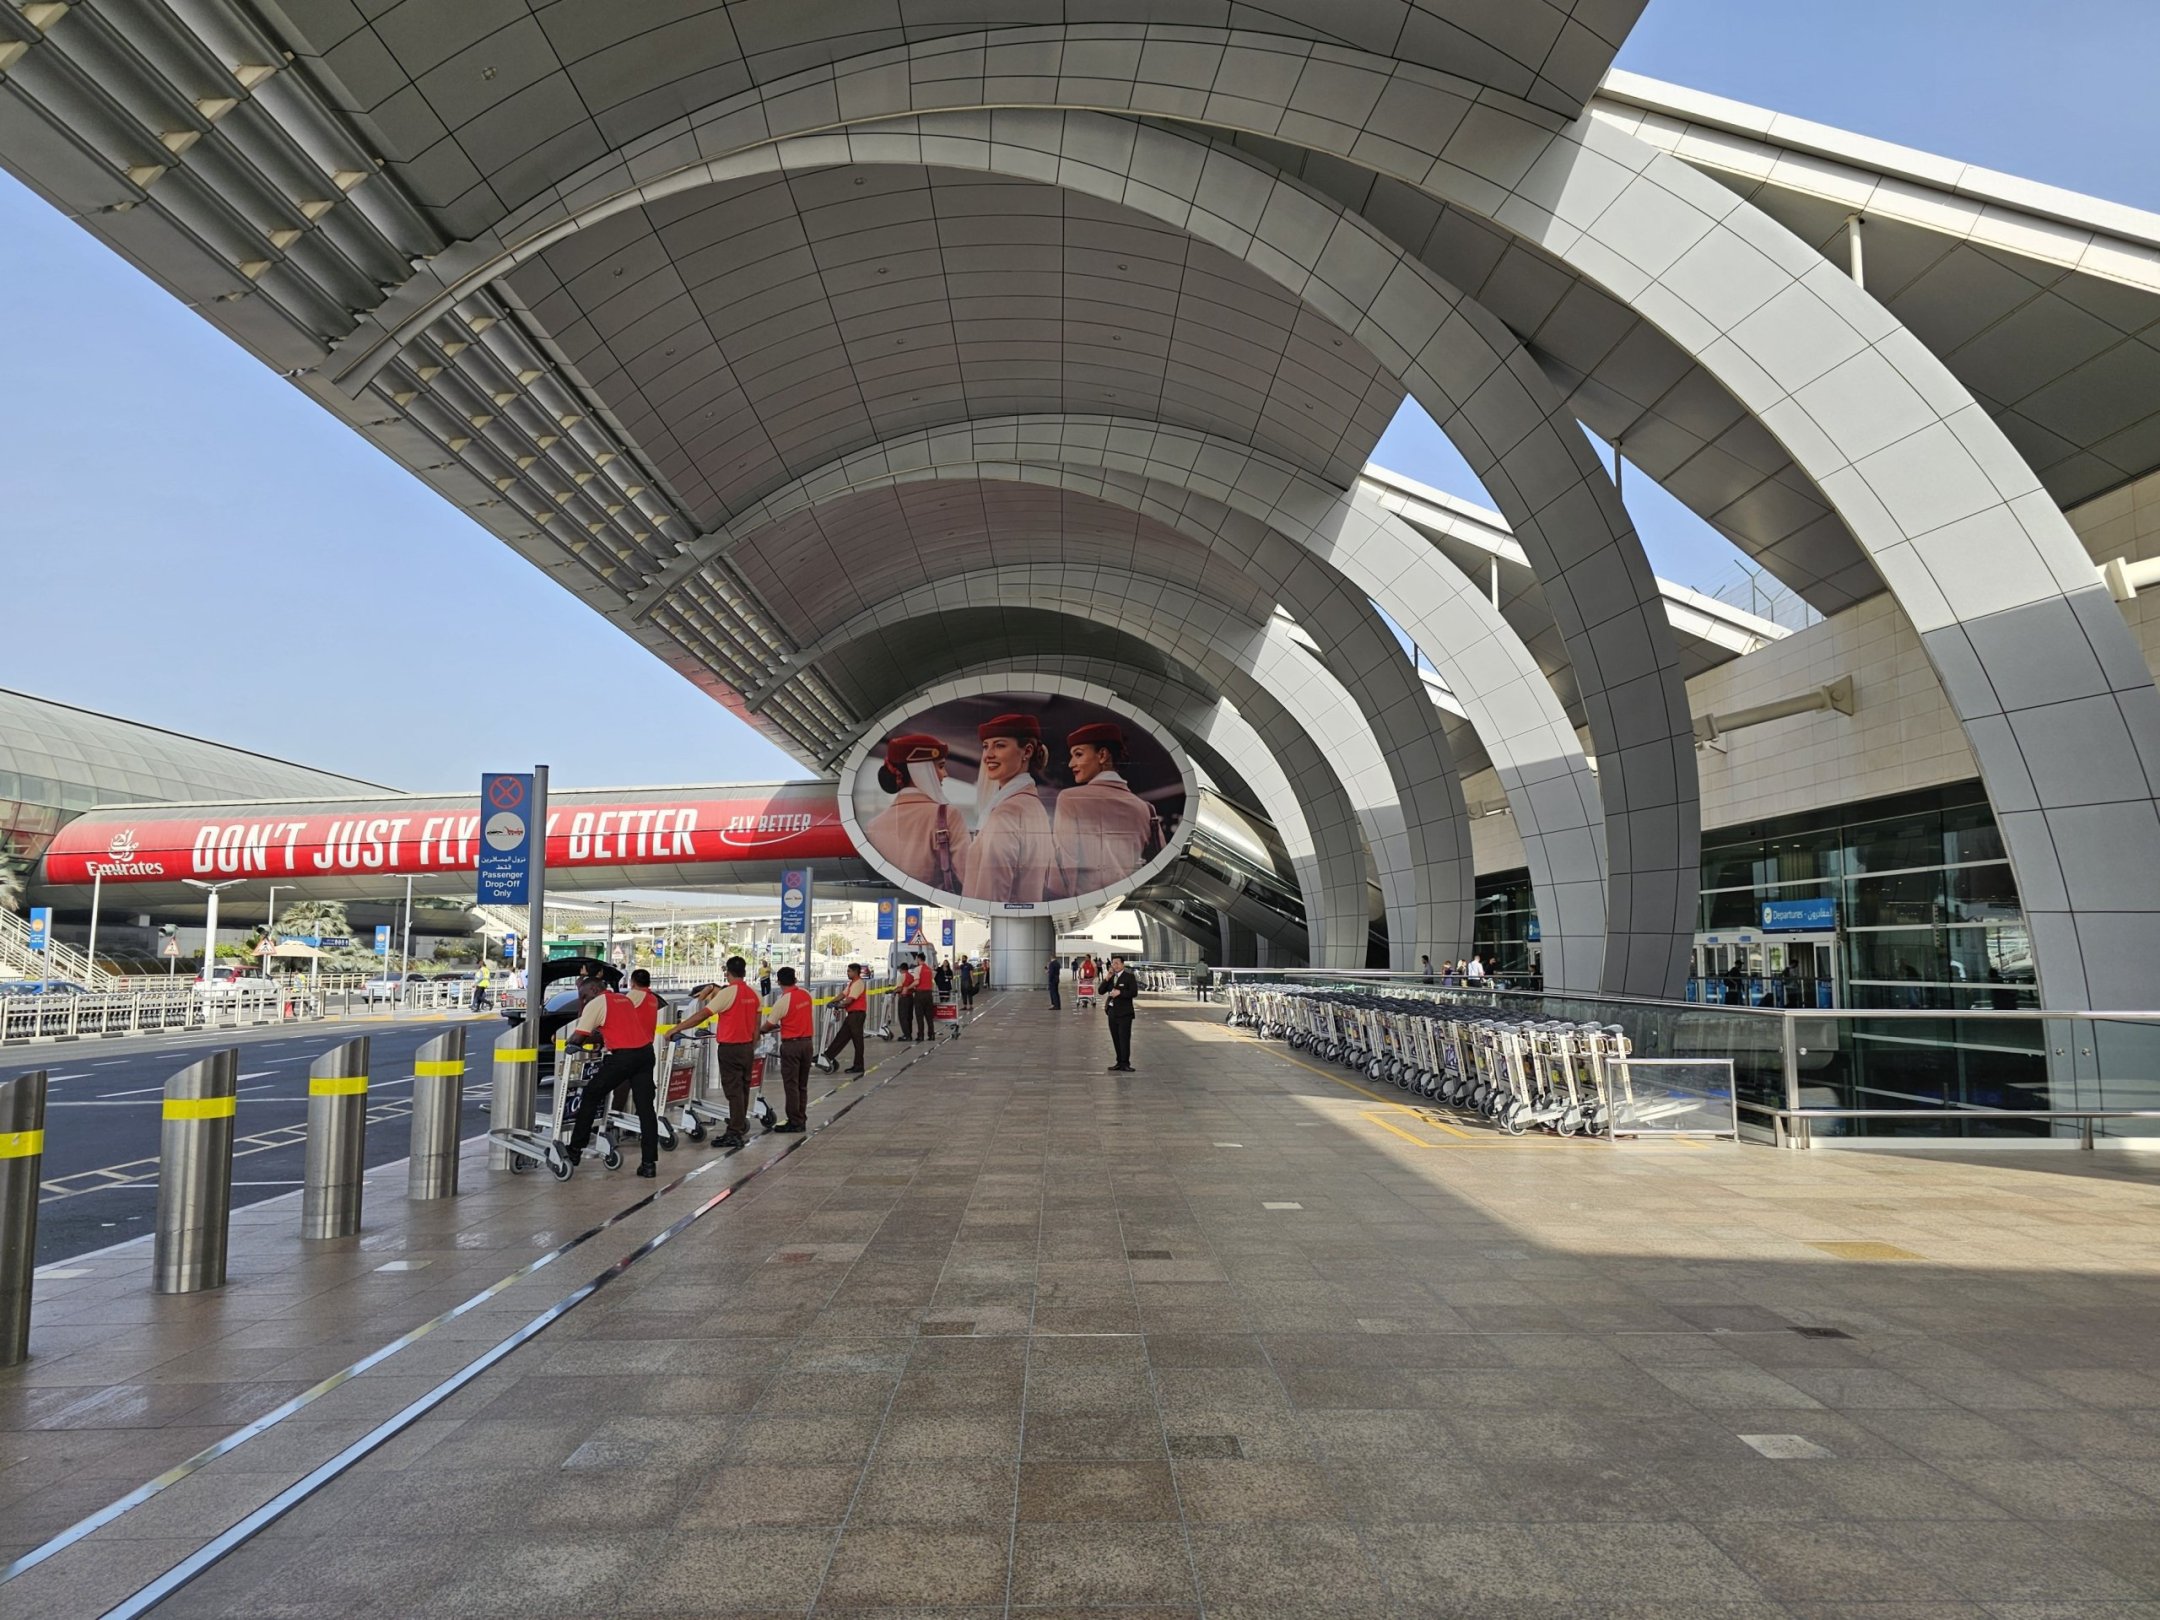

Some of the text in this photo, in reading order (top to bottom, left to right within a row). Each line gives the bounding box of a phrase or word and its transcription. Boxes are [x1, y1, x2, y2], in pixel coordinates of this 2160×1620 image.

[729, 812, 812, 834] FLY BETTER
[191, 822, 308, 873] DON'T
[313, 818, 411, 869] JUST
[568, 808, 699, 860] BETTER
[85, 860, 164, 876] Emirates
[482, 871, 524, 879] Passenger
[485, 880, 520, 888] Drop-Off
[493, 889, 512, 897] Only
[1773, 910, 1803, 920] Departures
